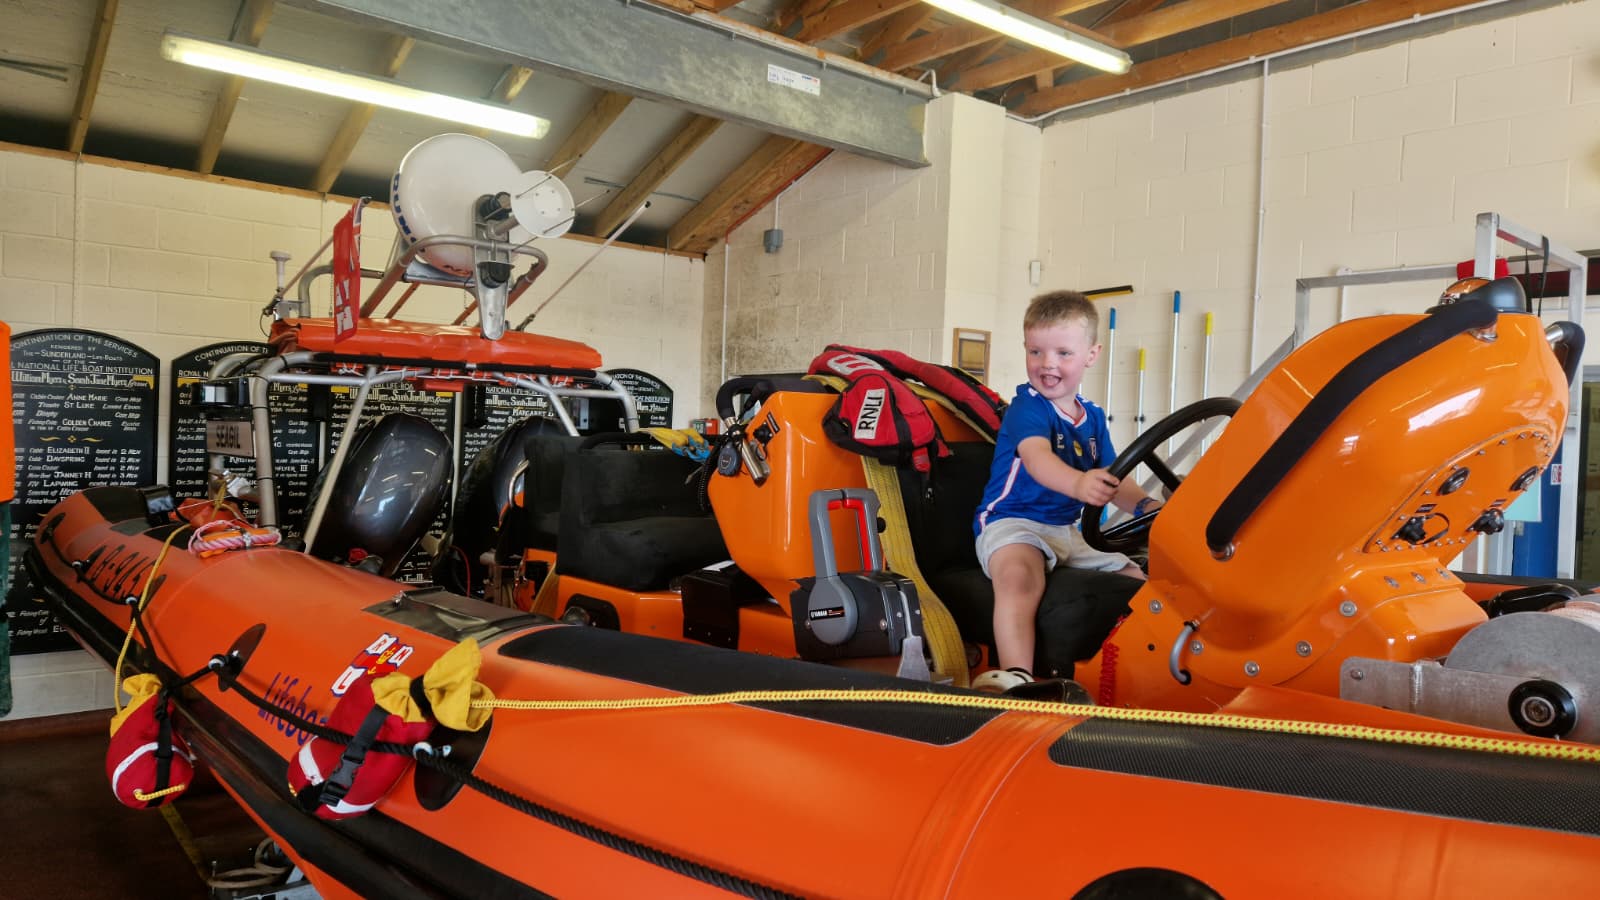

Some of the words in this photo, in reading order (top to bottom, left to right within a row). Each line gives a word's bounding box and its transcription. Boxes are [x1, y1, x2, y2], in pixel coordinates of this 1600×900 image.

[88, 335, 102, 345] THE
[104, 340, 138, 359] SERVICES
[40, 349, 87, 359] SUNDERLAND
[194, 345, 249, 362] CONTINUATION
[250, 345, 261, 353] OF
[17, 361, 61, 371] NATIONAL
[106, 365, 154, 375] INSTITUTION
[66, 392, 88, 401] ANNE
[88, 393, 109, 402] MARIE
[63, 400, 75, 409] ST
[76, 401, 95, 409] LUKE
[379, 403, 400, 412] OCEAN
[858, 396, 883, 430] RNLI
[62, 418, 88, 426] GOLDEN
[88, 417, 113, 427] CHANCE
[47, 446, 84, 454] ELIZABETH
[46, 454, 85, 463] DAYSPRING
[53, 471, 83, 479] JANNET
[43, 479, 79, 488] LAPWING
